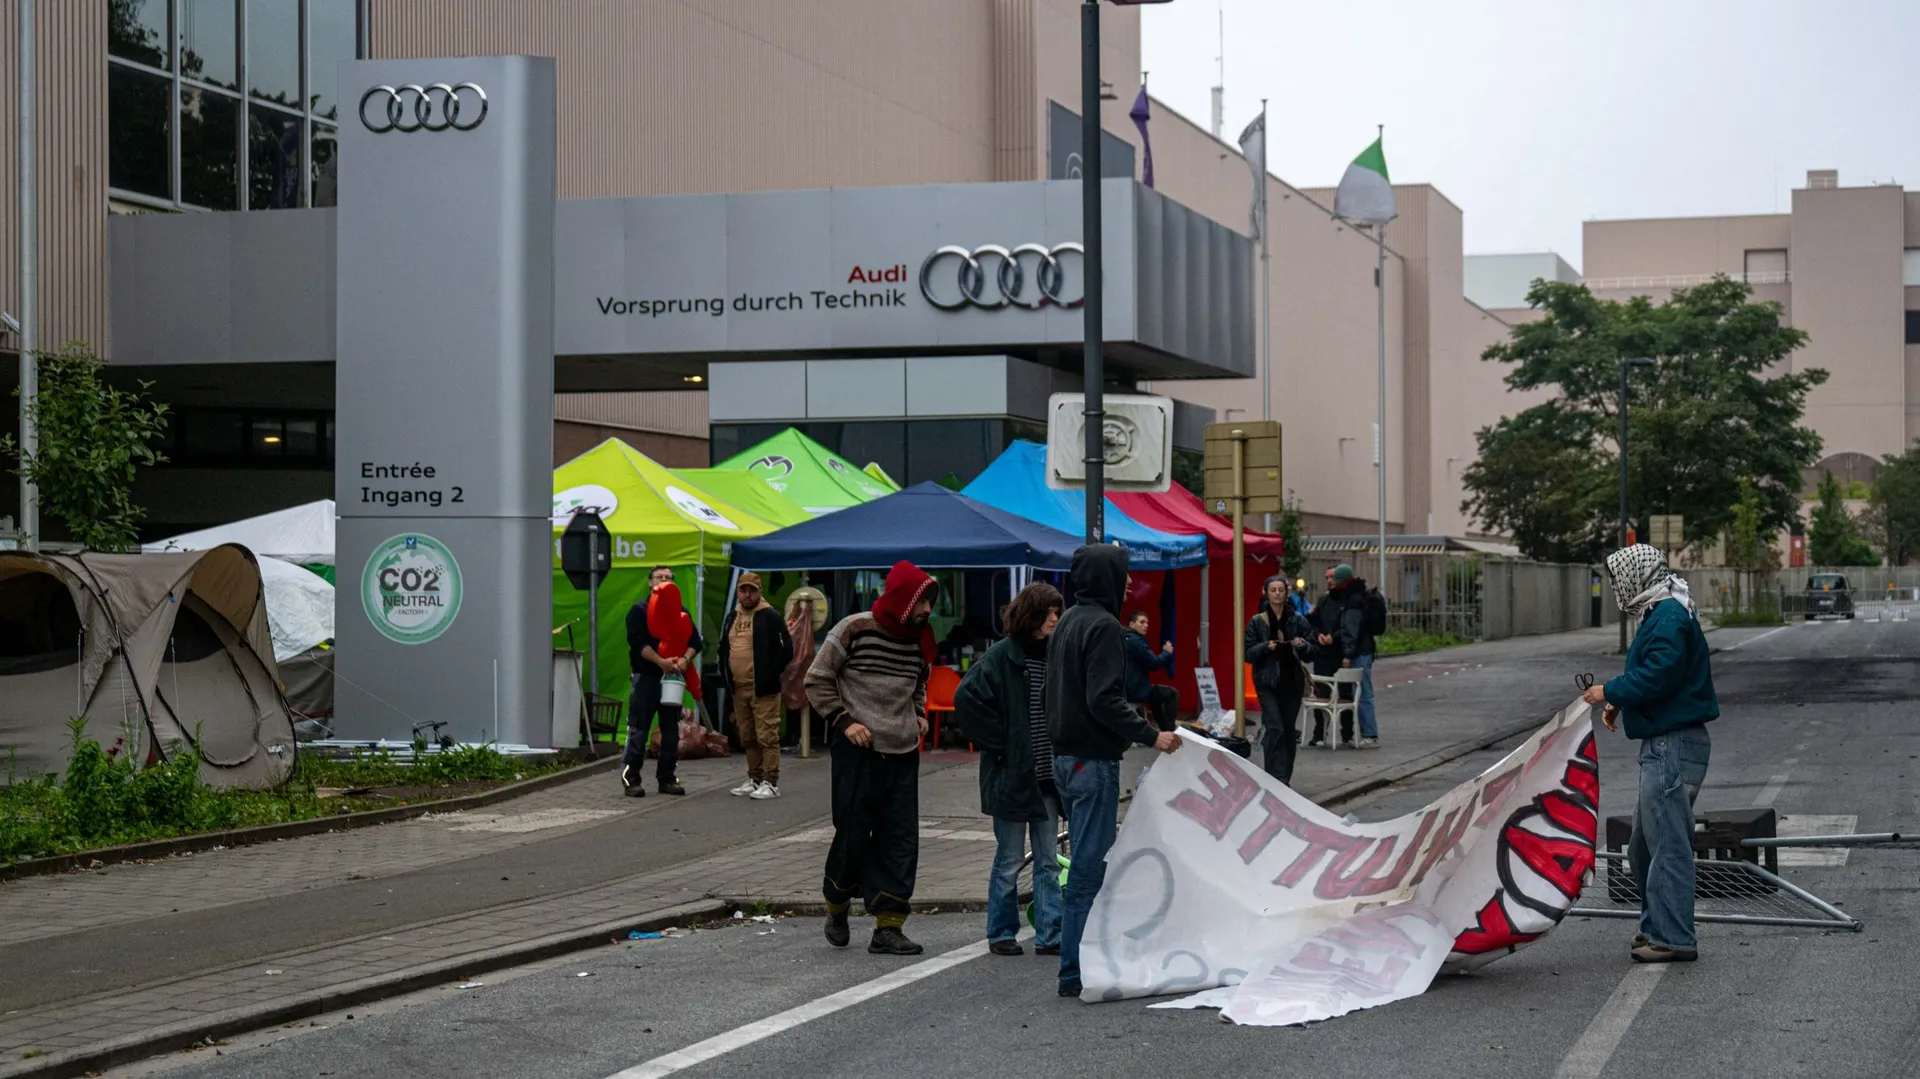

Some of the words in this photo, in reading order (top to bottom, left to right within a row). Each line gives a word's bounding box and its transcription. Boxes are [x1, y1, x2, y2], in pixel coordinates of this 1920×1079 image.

[847, 264, 907, 284] Audi
[596, 296, 725, 319] Vorsprung
[732, 292, 804, 312] durch
[810, 288, 907, 310] Technik
[361, 461, 437, 479] Entrée
[361, 486, 443, 507] Ingang
[450, 485, 465, 503] 2
[379, 567, 442, 592] CO2
[382, 594, 445, 608] NEUTRAL
[397, 608, 426, 616] FACTORY
